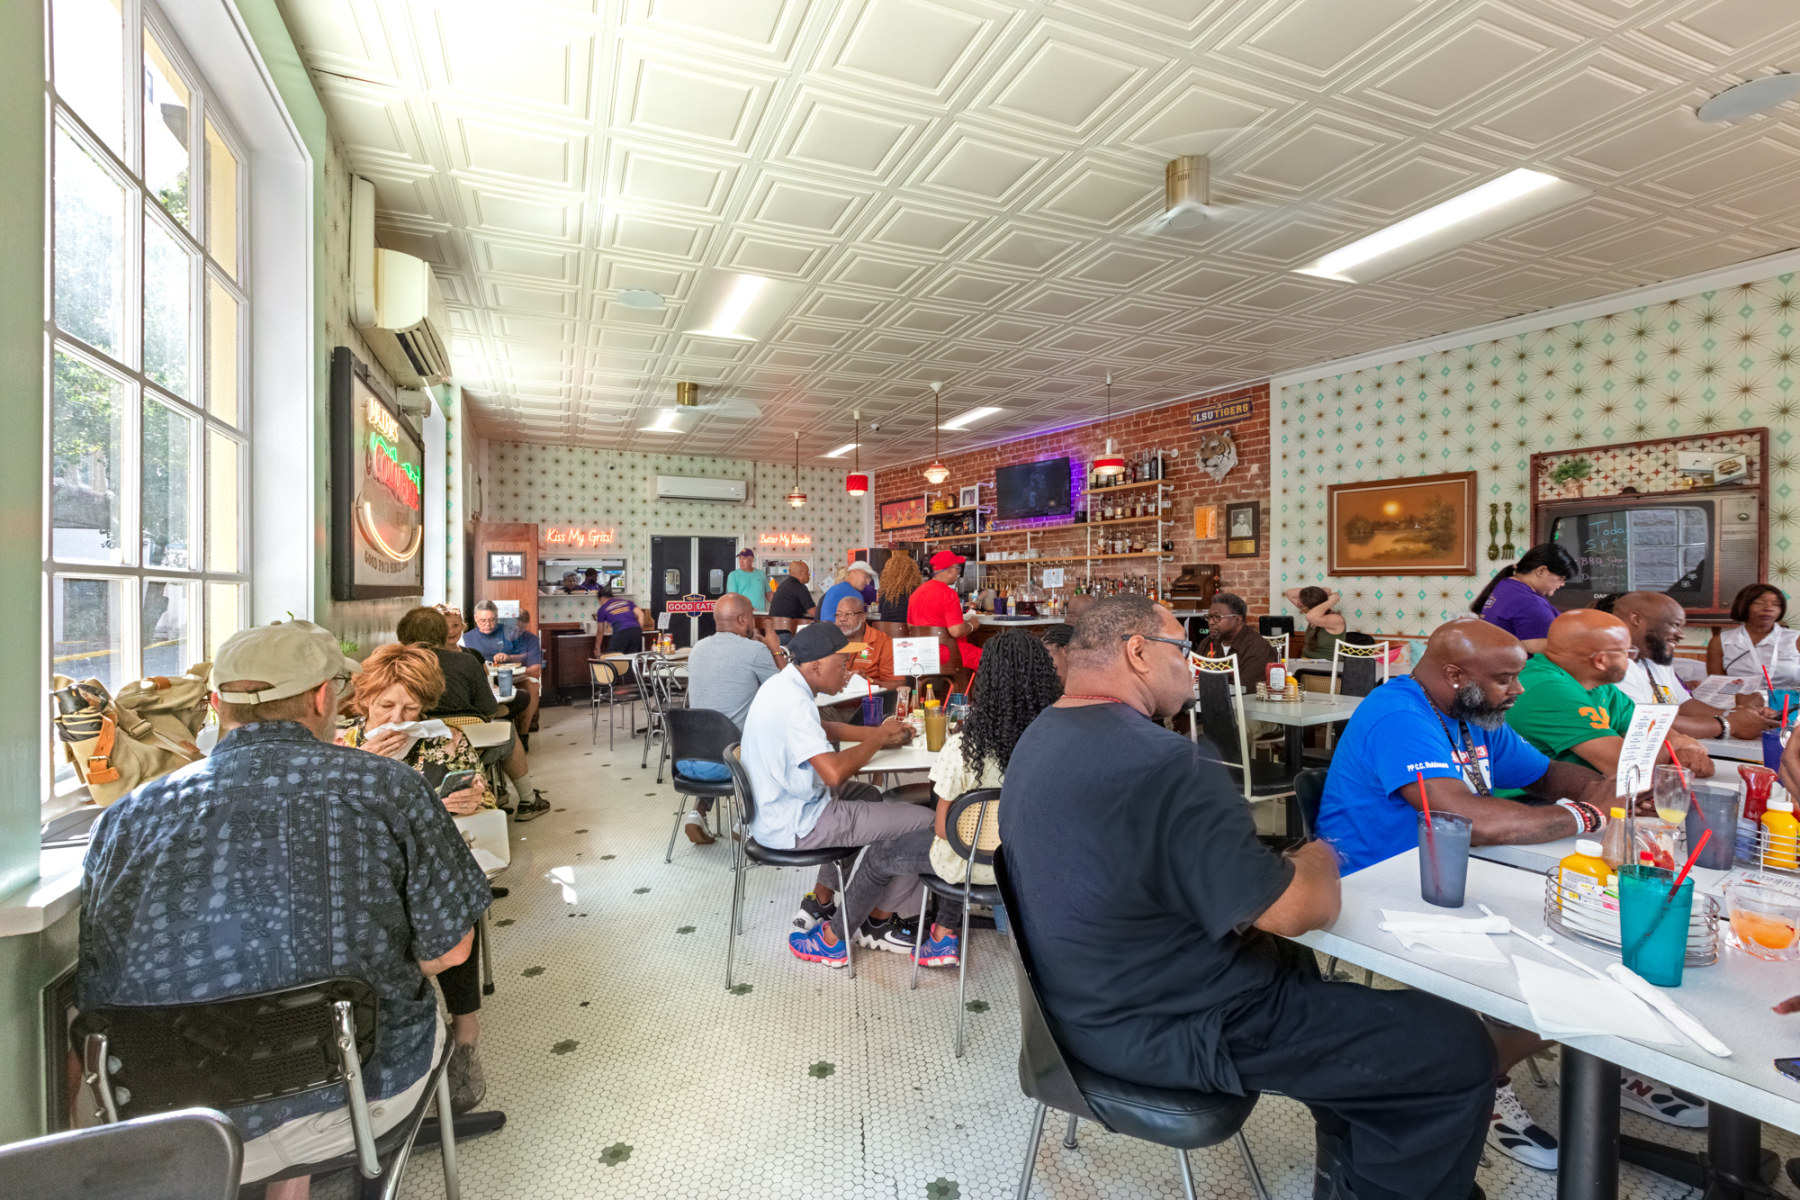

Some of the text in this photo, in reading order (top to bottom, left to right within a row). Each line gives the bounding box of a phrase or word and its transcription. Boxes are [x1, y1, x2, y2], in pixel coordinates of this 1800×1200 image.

[546, 528, 614, 547] Kiss My Grits!
[779, 533, 790, 548] My
